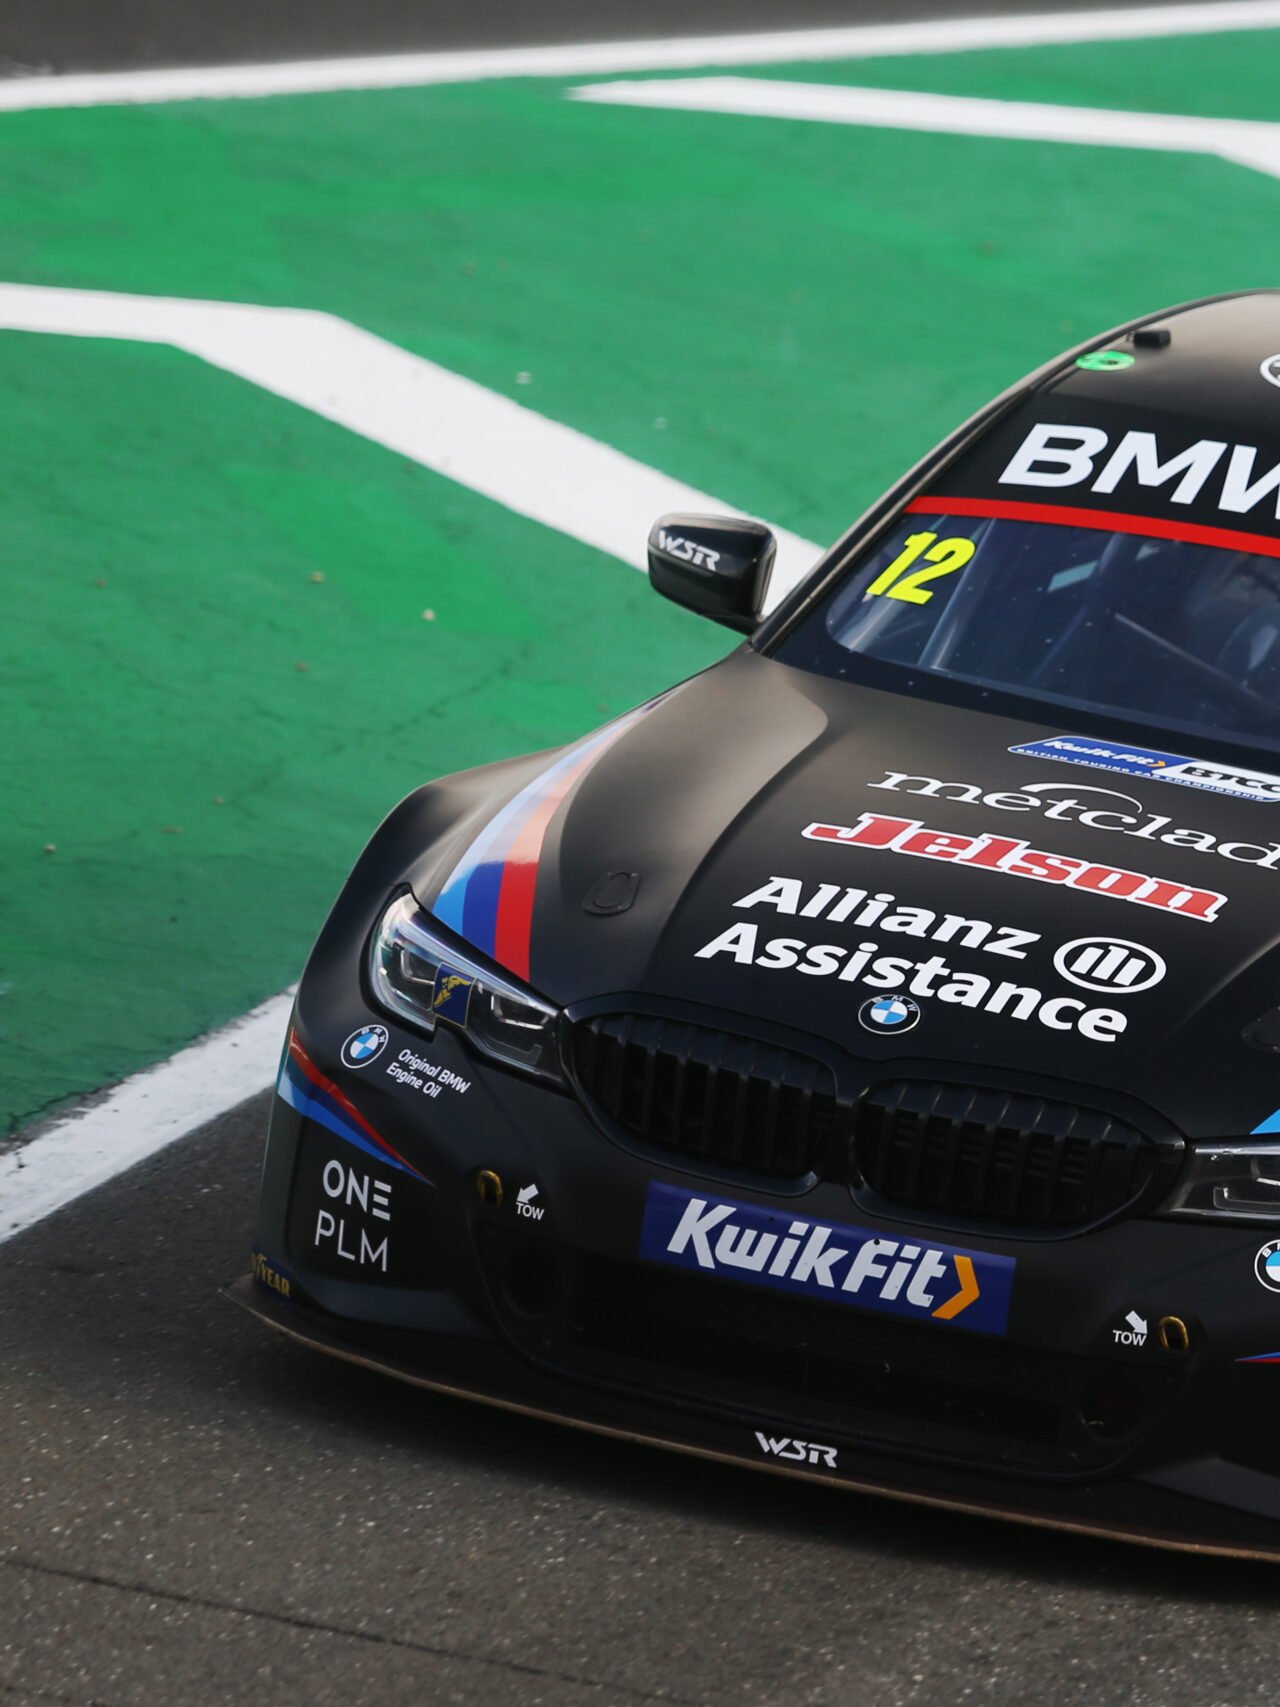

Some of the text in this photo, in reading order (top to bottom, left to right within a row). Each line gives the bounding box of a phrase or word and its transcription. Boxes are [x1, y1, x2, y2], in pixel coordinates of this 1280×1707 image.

[657, 529, 721, 572] WSR
[865, 530, 976, 606] 12
[1015, 747, 1266, 801] BRITISH TOURING CAR CHAMPIONSHIP
[800, 811, 1230, 924] Jelson
[731, 874, 1042, 960] Allianz
[693, 921, 1128, 1044] Assistance
[385, 1062, 443, 1099] Engine Oil
[397, 1048, 440, 1081] Original
[438, 1067, 472, 1096] BMW
[321, 1158, 393, 1222] ONE
[515, 1201, 545, 1222] TOW
[313, 1208, 389, 1273] PLM
[1112, 1329, 1147, 1348] TOW
[754, 1430, 838, 1469] WSR
